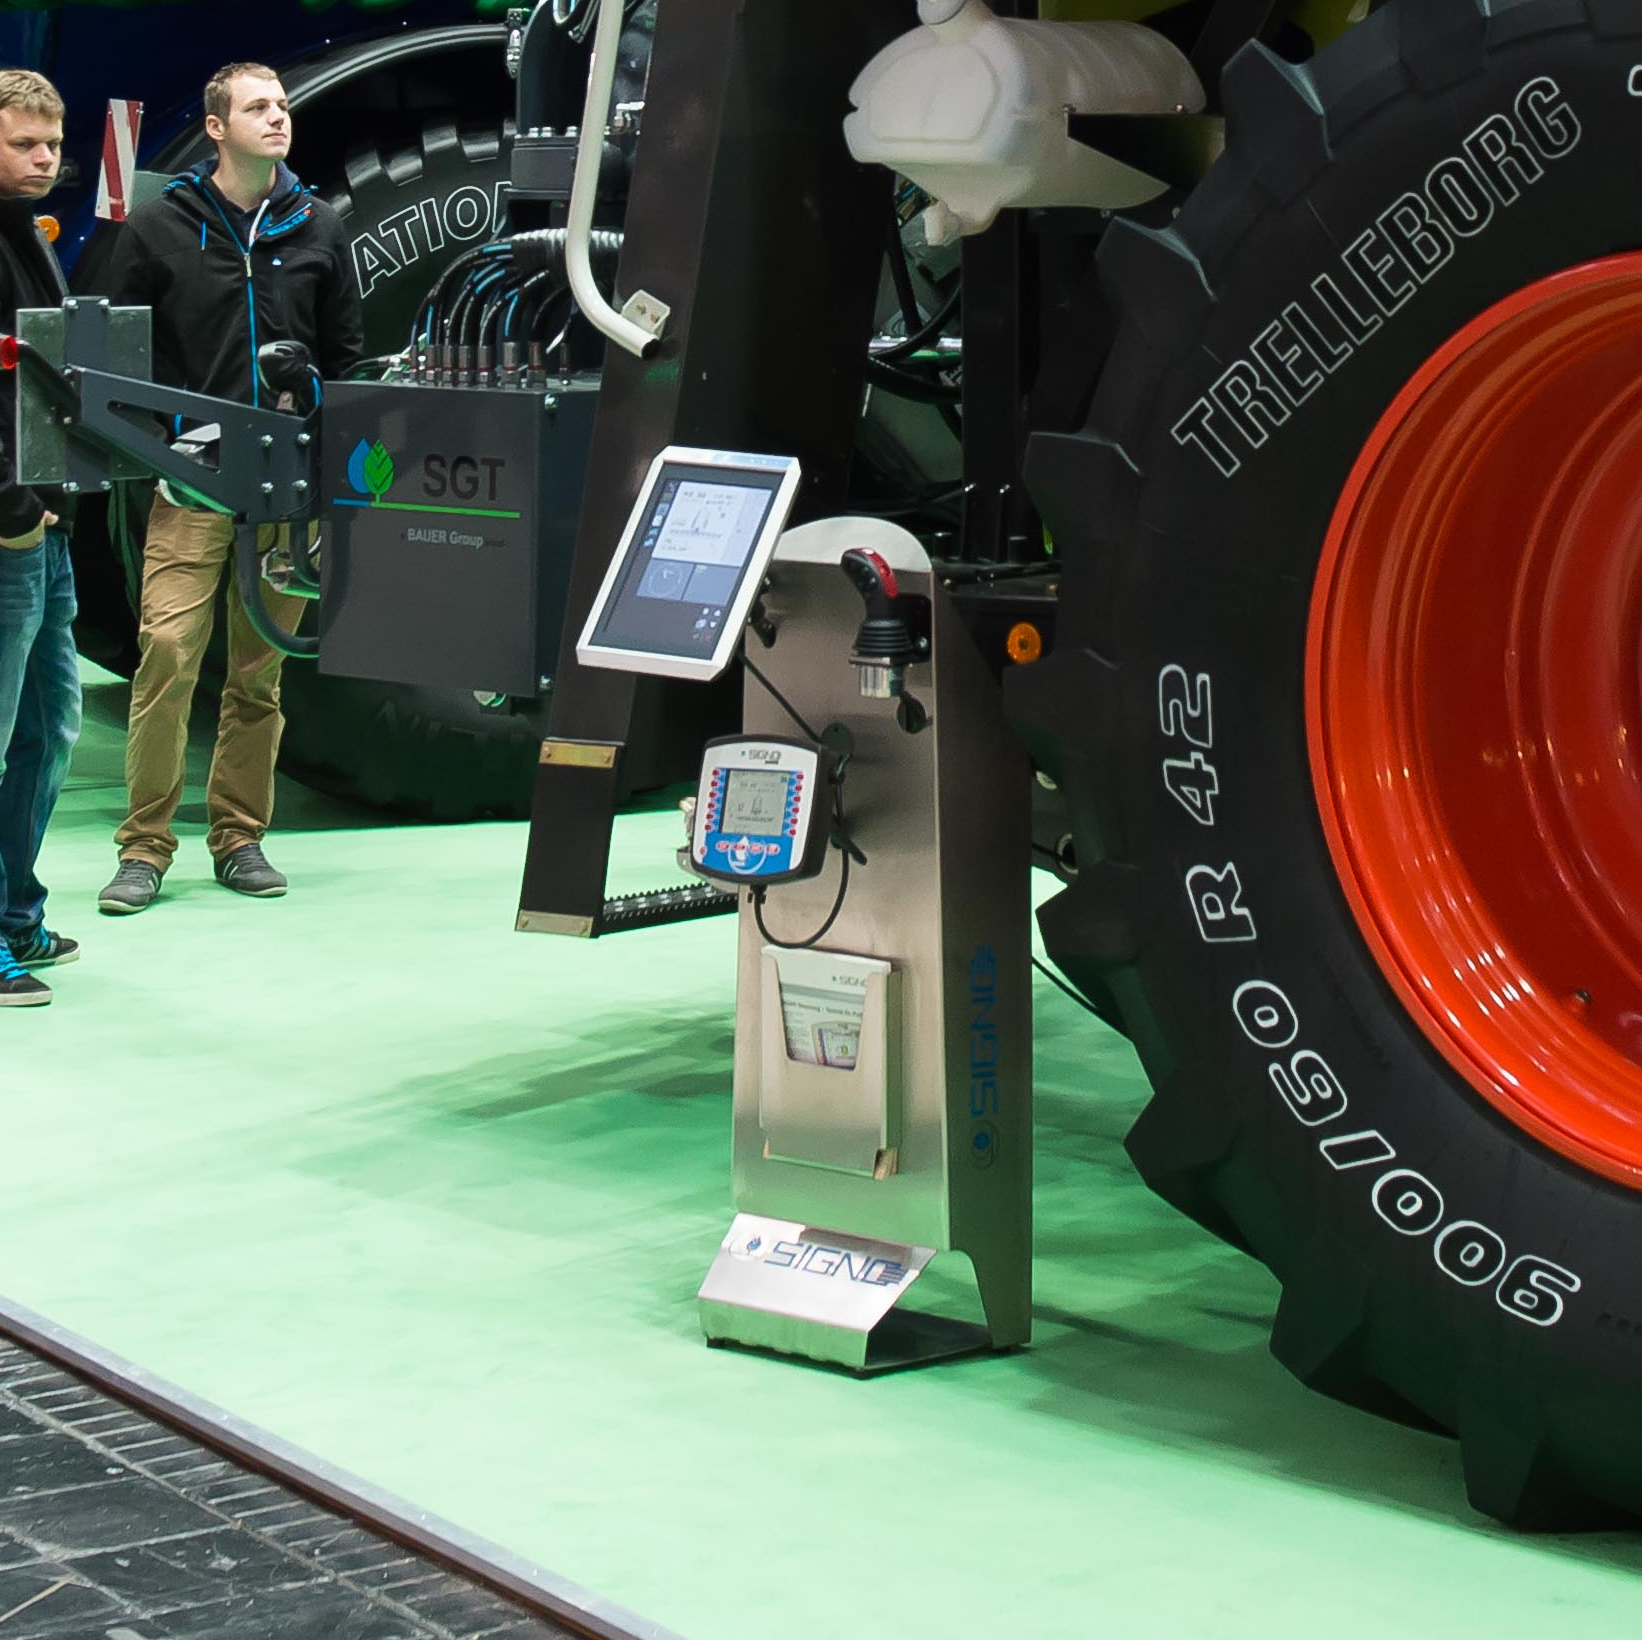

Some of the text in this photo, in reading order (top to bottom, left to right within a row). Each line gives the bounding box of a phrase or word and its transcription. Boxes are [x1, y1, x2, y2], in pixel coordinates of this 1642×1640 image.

[1171, 76, 1581, 477] TRELLEBORG
[407, 527, 447, 544] BAUER
[449, 530, 484, 549] Group
[423, 453, 505, 501] SGT
[1158, 663, 1581, 1327] 900/50 R 42
